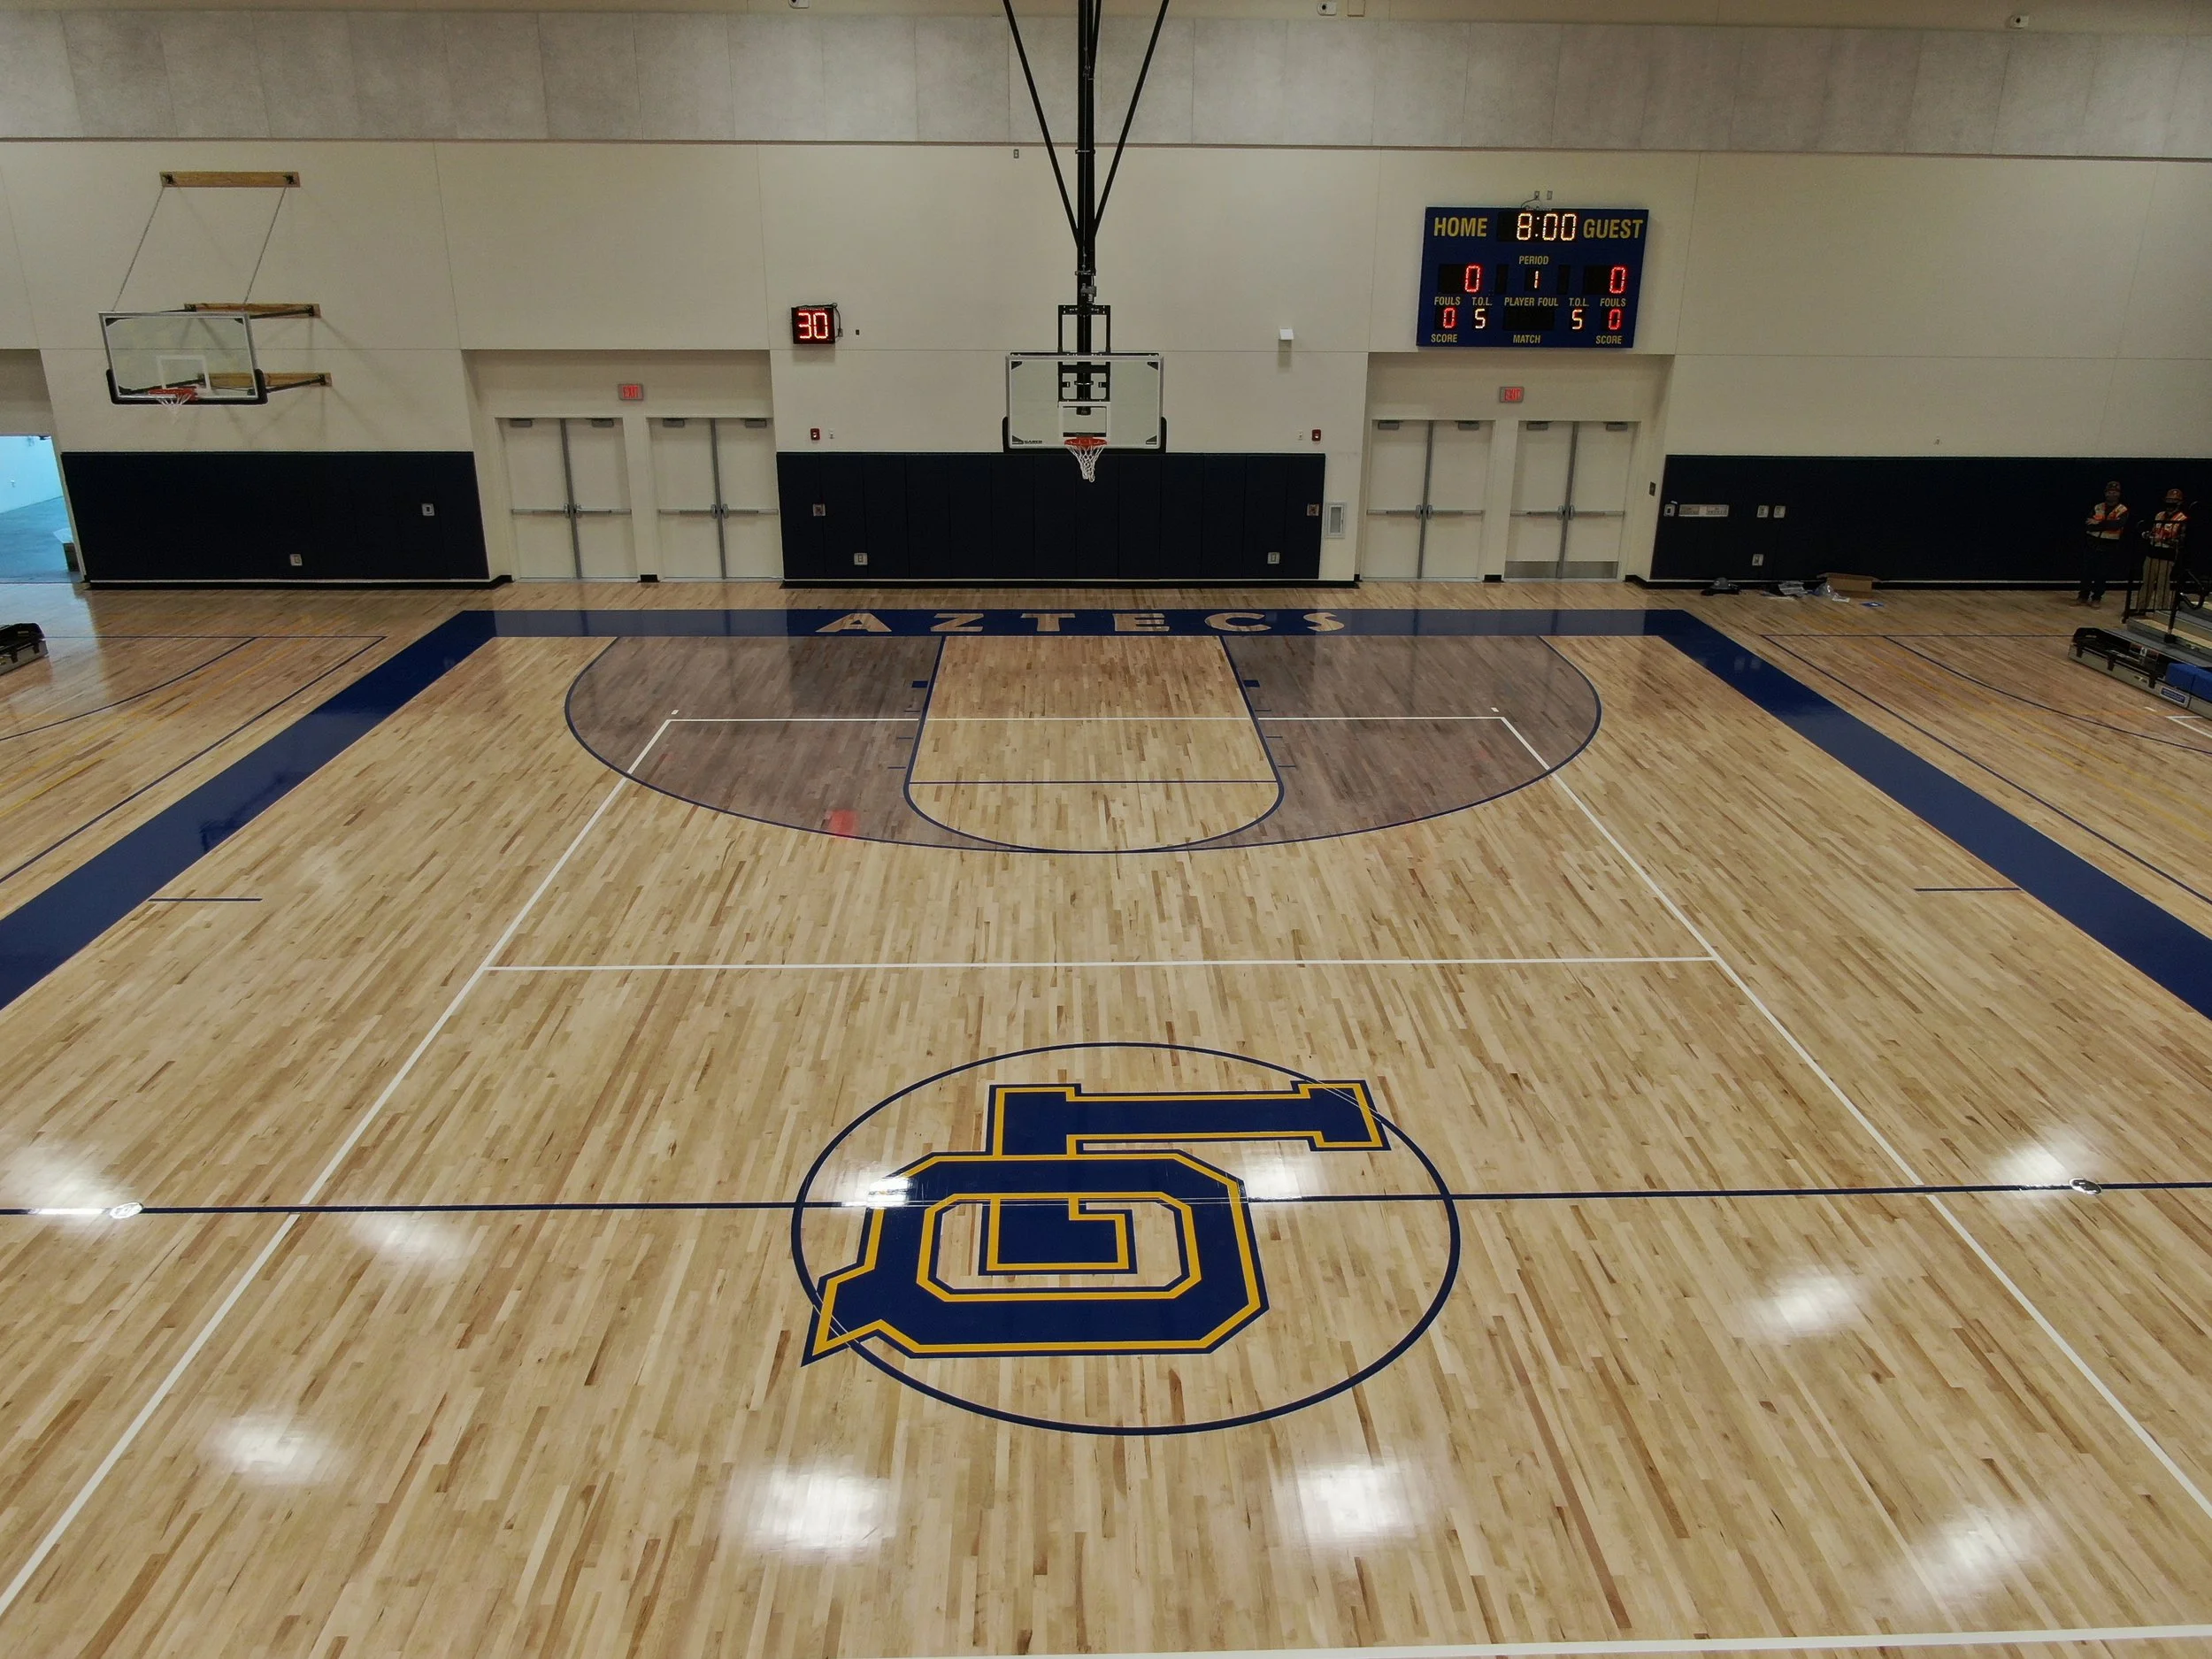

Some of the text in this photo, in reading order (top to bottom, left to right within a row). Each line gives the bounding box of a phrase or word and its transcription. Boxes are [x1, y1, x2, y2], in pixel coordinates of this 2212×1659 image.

[1433, 217, 1488, 237] HOME
[1516, 212, 1577, 241] 8:00
[1582, 219, 1643, 239] GUEST
[1518, 255, 1549, 265] PERIOD
[1464, 265, 1480, 293] 0
[1533, 270, 1540, 288] 1
[1609, 266, 1626, 294] 0
[1433, 296, 1461, 306] FOULS
[1471, 296, 1494, 306] T.O.L.
[1503, 296, 1559, 307] PLAYER FOUL
[1568, 297, 1590, 307] T.O.L.
[1599, 298, 1626, 307] FOULS
[798, 312, 828, 339] 30
[1443, 307, 1455, 328] 0
[1474, 308, 1486, 329] 5
[1571, 309, 1584, 330] 5
[1608, 308, 1622, 330] 0
[1431, 334, 1458, 343] SCORE
[1513, 334, 1541, 344] MATCH
[1595, 335, 1623, 344] SCORE
[815, 611, 1345, 633] AZTECS
